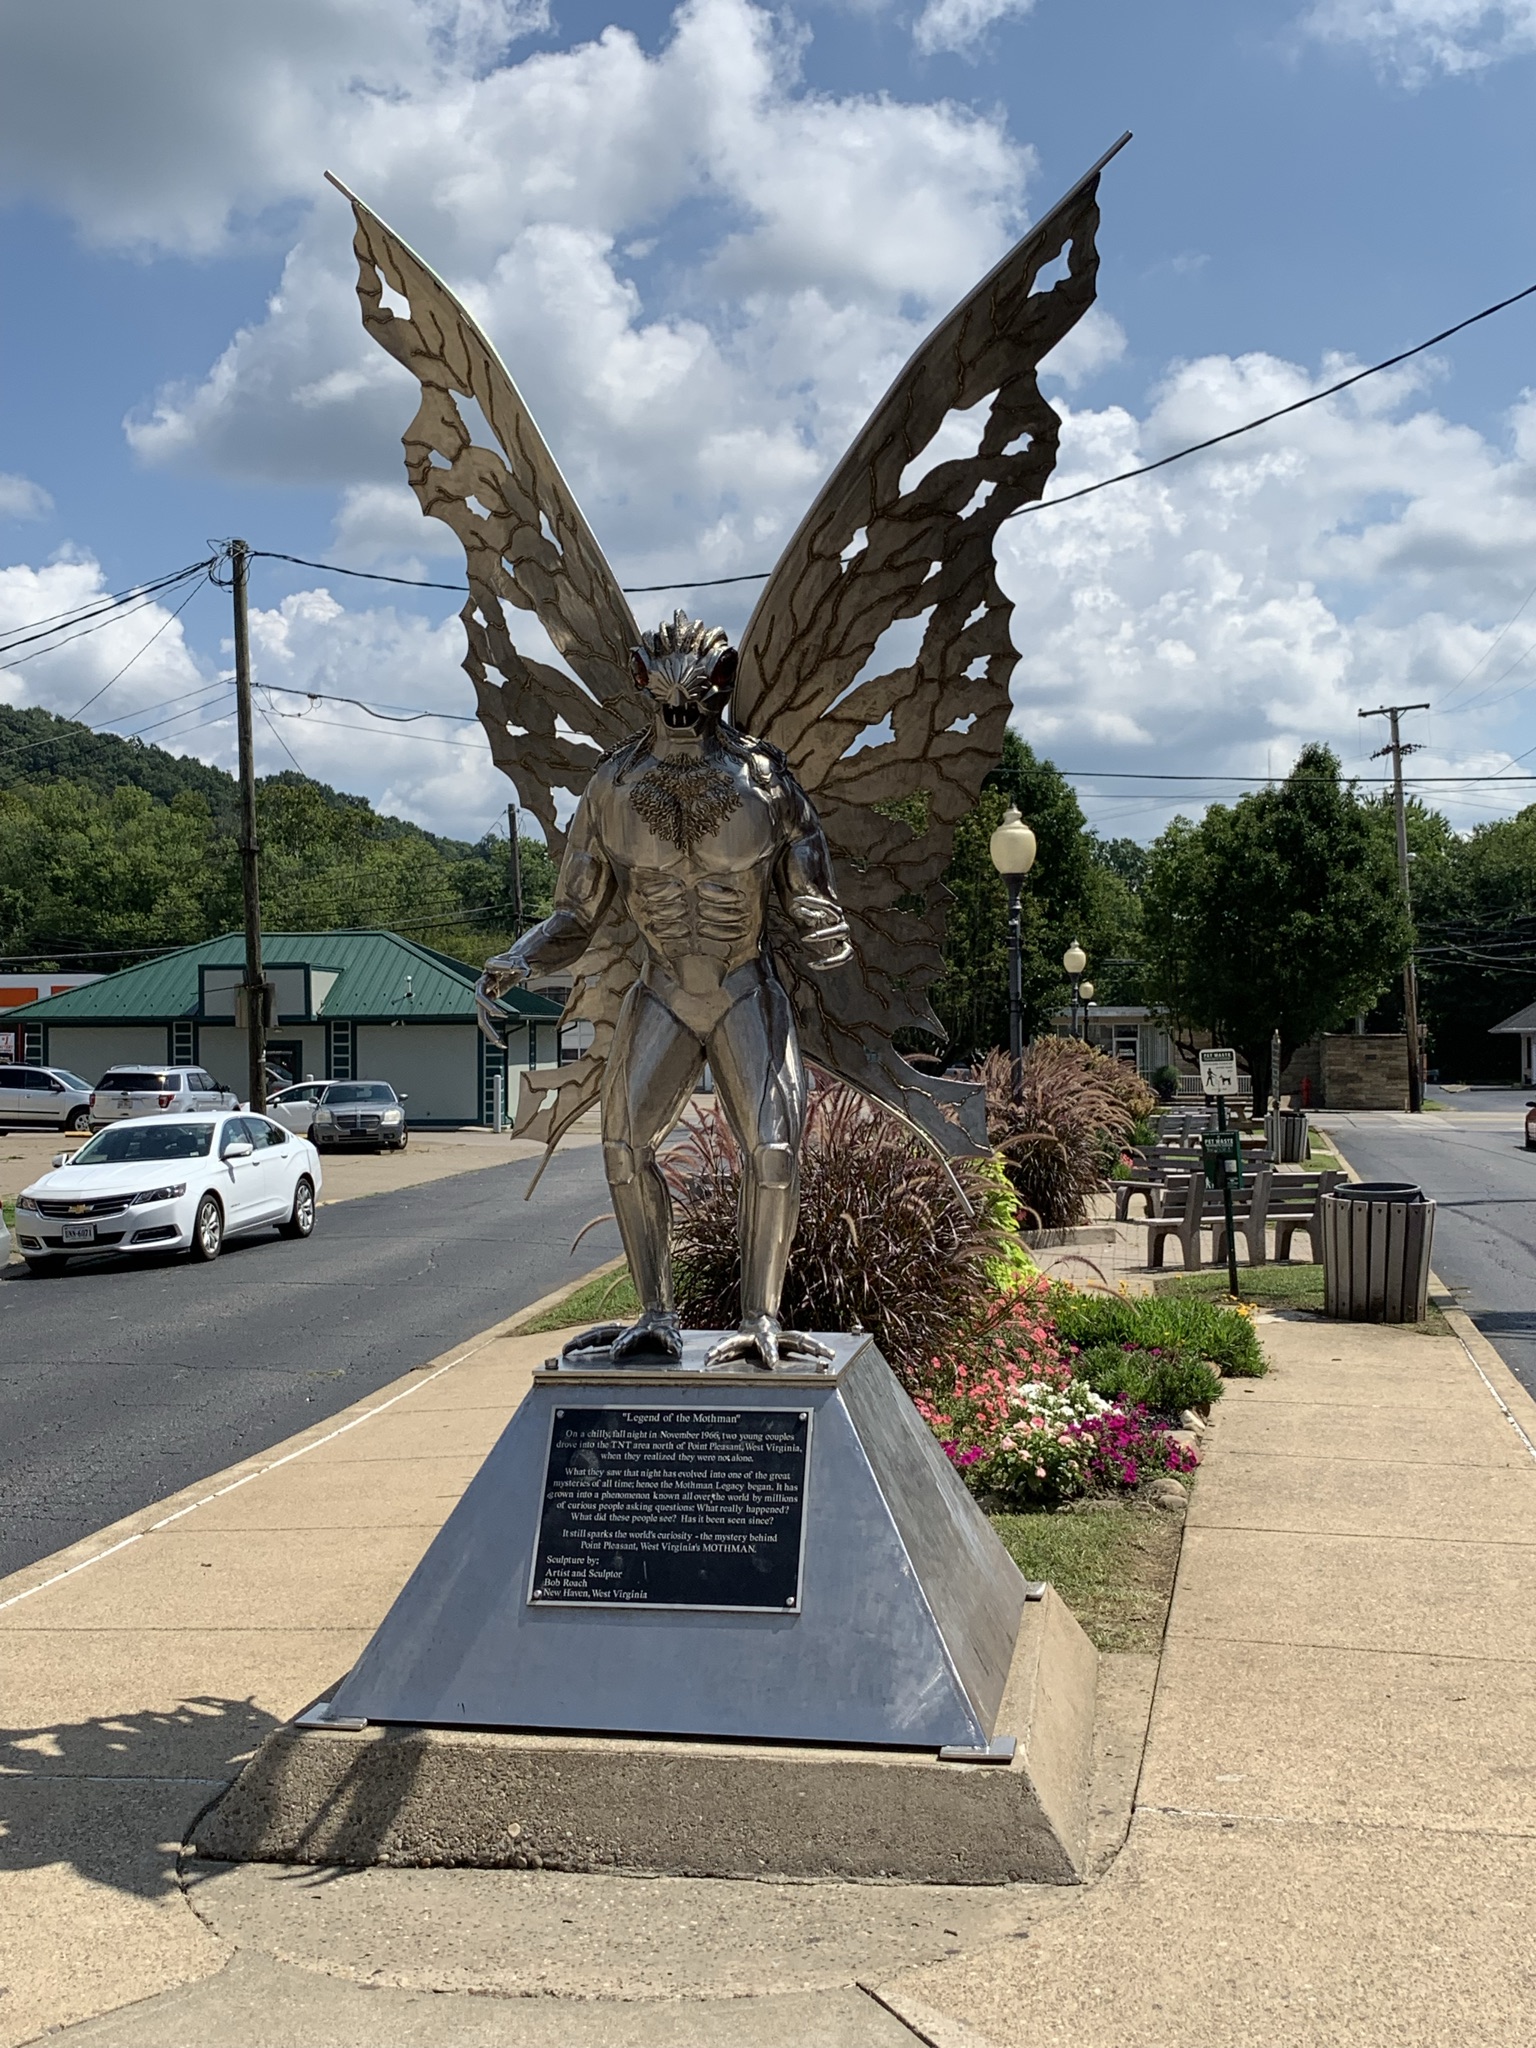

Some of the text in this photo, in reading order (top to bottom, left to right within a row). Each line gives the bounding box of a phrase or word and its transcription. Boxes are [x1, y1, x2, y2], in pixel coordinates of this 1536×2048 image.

[663, 1414, 674, 1422] of
[676, 1414, 690, 1422] the
[566, 1430, 578, 1438] On
[587, 1430, 611, 1439] chilly,
[612, 1430, 626, 1438] fall
[627, 1430, 647, 1440] night
[660, 1431, 700, 1439] November
[739, 1433, 763, 1441] young
[765, 1433, 794, 1441] couples
[676, 1442, 684, 1450] of
[688, 1442, 707, 1450] Point
[709, 1443, 744, 1451] Pleasant,
[766, 1444, 802, 1453] Virginia,
[601, 1452, 621, 1460] when
[624, 1452, 641, 1461] they
[644, 1452, 676, 1460] realized
[678, 1454, 695, 1462] they
[731, 1454, 754, 1462] alone.
[565, 1468, 586, 1476] What
[587, 1468, 604, 1477] they
[641, 1469, 661, 1478] night
[678, 1470, 707, 1478] evolved
[710, 1470, 726, 1478] into
[744, 1470, 752, 1479] of
[755, 1471, 767, 1479] the
[769, 1472, 791, 1481] great
[553, 1480, 590, 1488] mysteries
[592, 1479, 600, 1487] of
[636, 1480, 658, 1488] hence
[675, 1481, 713, 1489] Mothman
[716, 1482, 744, 1491] Legacy
[748, 1482, 774, 1492] began.
[776, 1483, 783, 1491] It
[784, 1483, 798, 1491] has
[547, 1491, 573, 1499] grown
[601, 1491, 650, 1500] phenomenon
[682, 1492, 692, 1500] all
[752, 1494, 761, 1503] by
[764, 1494, 798, 1502] millions
[598, 1502, 624, 1511] people
[626, 1502, 653, 1512] asking
[655, 1503, 695, 1512] questions:
[696, 1504, 718, 1512] What
[720, 1504, 743, 1513] really
[746, 1505, 790, 1515] happened?
[571, 1512, 592, 1521] What
[594, 1513, 606, 1521] did
[609, 1513, 630, 1521] these
[632, 1515, 658, 1523] people
[681, 1515, 696, 1523] Has
[698, 1515, 704, 1523] it
[705, 1515, 725, 1523] been
[748, 1516, 774, 1525] since?
[562, 1529, 569, 1537] It
[570, 1529, 586, 1538] still
[587, 1530, 613, 1540] sparks
[615, 1530, 627, 1538] the
[629, 1531, 656, 1539] world's
[657, 1531, 692, 1540] curiosity
[700, 1532, 712, 1540] the
[714, 1534, 747, 1542] mystery
[750, 1533, 778, 1542] behind
[581, 1541, 601, 1549] Point
[603, 1542, 638, 1551] Pleasant,
[641, 1542, 659, 1550] West
[662, 1543, 700, 1553] Virginia's
[546, 1555, 600, 1566] Sculpture by:
[545, 1568, 623, 1579] Artist and Sculptor
[563, 1579, 588, 1587] Roach
[563, 1589, 590, 1598] Haven,
[592, 1589, 610, 1598] West
[613, 1590, 648, 1600] Virginia
